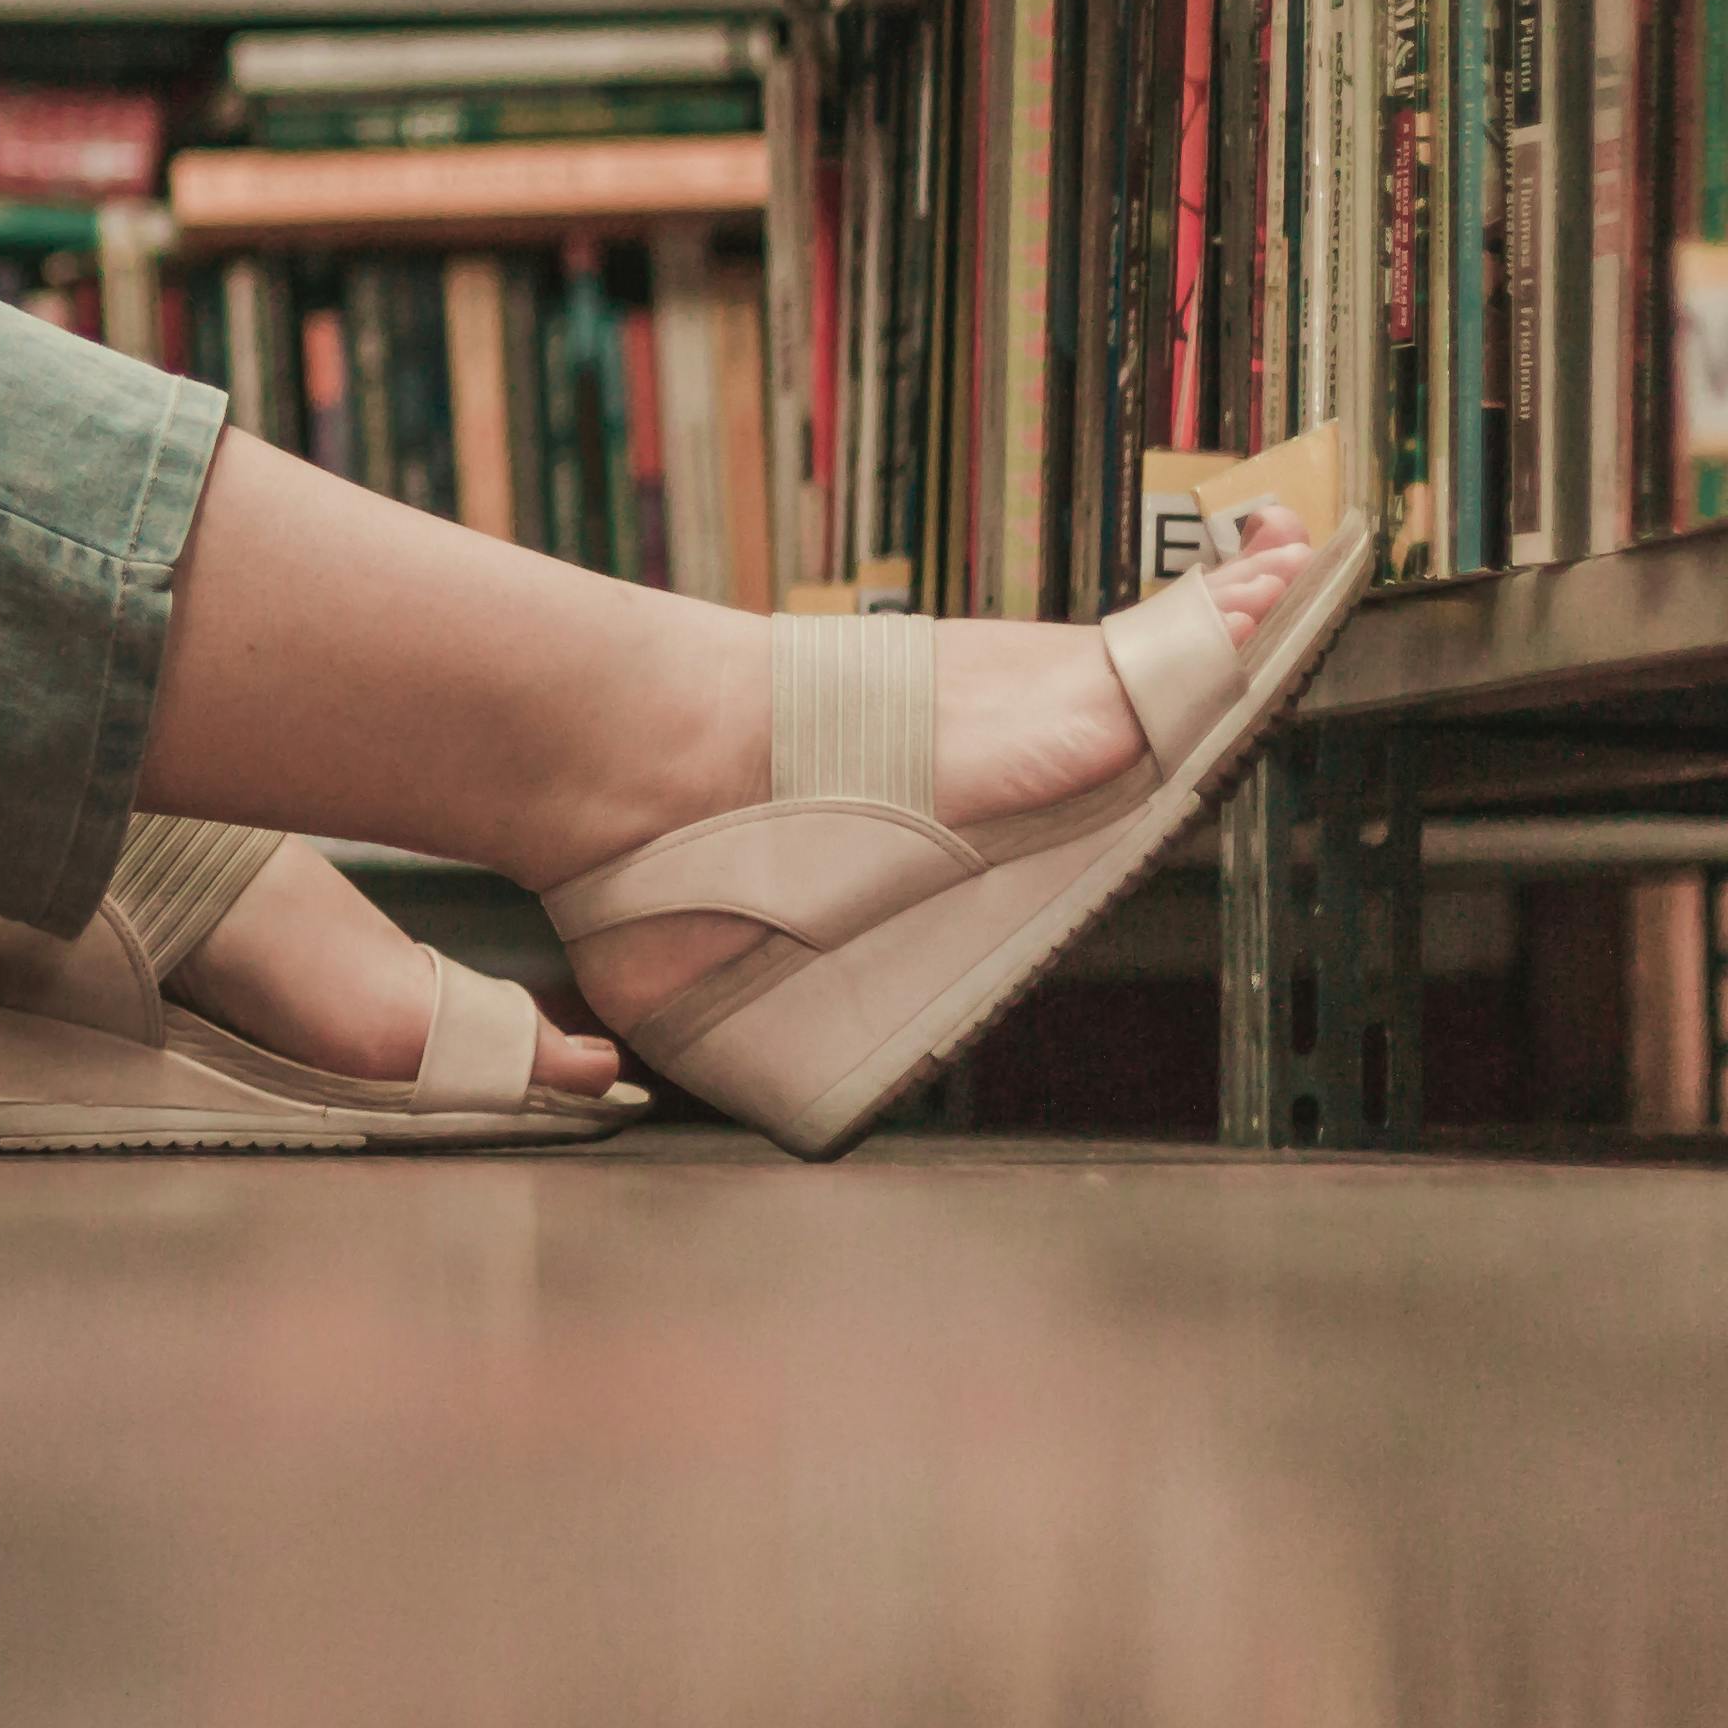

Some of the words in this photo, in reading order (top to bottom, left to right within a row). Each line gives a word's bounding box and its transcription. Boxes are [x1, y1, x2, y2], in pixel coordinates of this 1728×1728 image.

[1335, 31, 1343, 158] MODERN
[1520, 17, 1536, 92] Plano
[1462, 102, 1475, 248] Financeiro
[1520, 177, 1533, 268] Thomas
[1331, 168, 1342, 333] PORTFOLIO
[1520, 305, 1533, 420] Friedman
[1155, 513, 1201, 577] E
